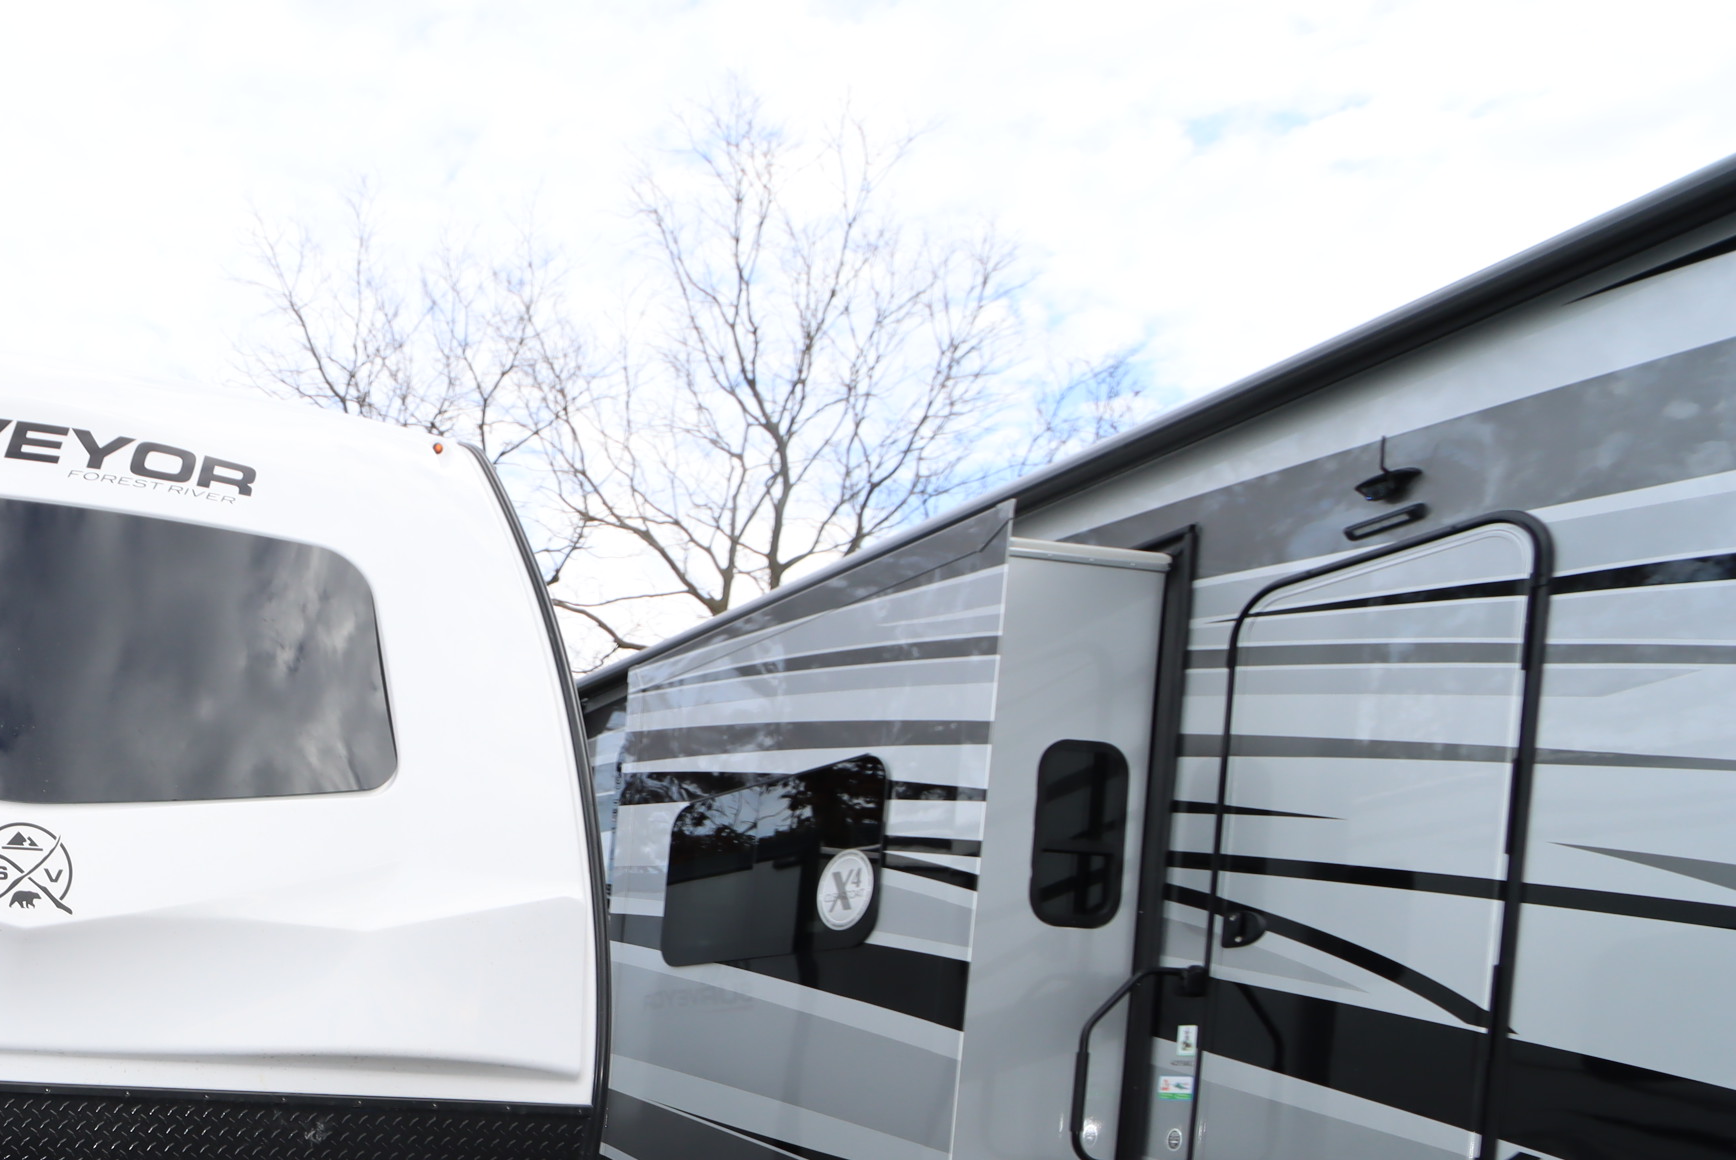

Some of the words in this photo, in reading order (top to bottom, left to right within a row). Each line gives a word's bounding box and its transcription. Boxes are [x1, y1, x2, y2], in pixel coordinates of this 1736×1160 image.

[67, 469, 165, 490] FOREST
[167, 484, 236, 505] RIVER
[43, 868, 63, 883] V
